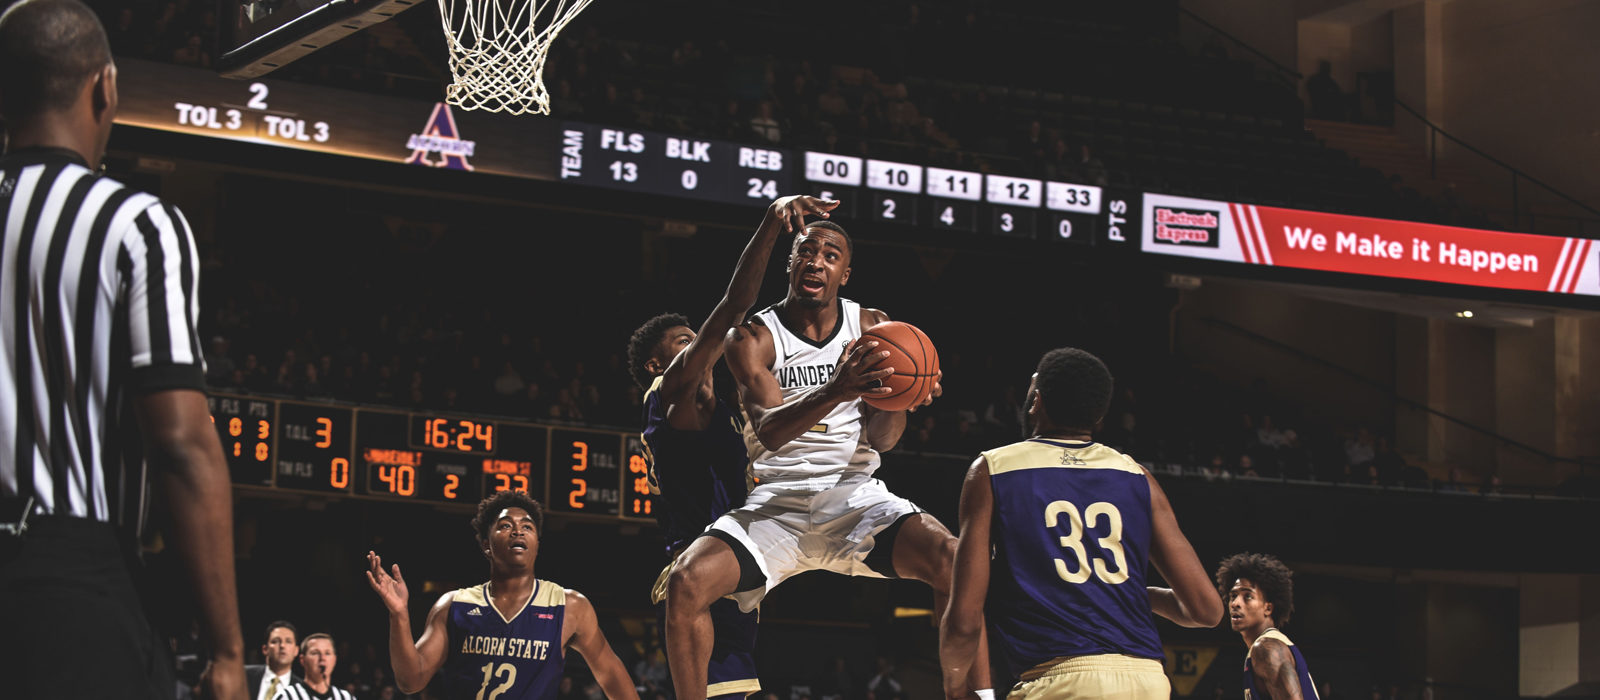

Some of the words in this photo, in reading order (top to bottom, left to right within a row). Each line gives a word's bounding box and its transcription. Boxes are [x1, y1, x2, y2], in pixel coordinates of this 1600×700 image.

[248, 83, 268, 110] 2
[175, 103, 222, 129] TOL
[227, 110, 242, 129] 3
[264, 115, 310, 140] TOL
[314, 122, 330, 142] 3
[600, 129, 645, 153] FLS
[665, 138, 711, 162] BLK
[561, 130, 583, 178] TEAM
[739, 147, 783, 171] REB
[609, 161, 638, 182] 13
[681, 170, 698, 190] 0
[823, 159, 849, 178] 00
[885, 169, 909, 186] 10
[747, 178, 778, 200] 24
[945, 176, 968, 193] 11
[1006, 182, 1030, 200] 12
[882, 199, 896, 219] 2
[1065, 188, 1091, 206] 33
[940, 206, 954, 226] 4
[1001, 213, 1014, 232] 3
[1108, 200, 1127, 242] PTS
[1156, 209, 1217, 228] Electronic
[1059, 219, 1072, 238] 0
[1156, 224, 1209, 243] Express
[1283, 226, 1327, 251] We
[1336, 231, 1403, 259] Make
[1412, 238, 1431, 262] it
[1439, 243, 1538, 273] Happen
[258, 420, 270, 440] 3
[315, 417, 332, 448] 3
[424, 419, 493, 451] 16:24
[571, 441, 588, 471] 3
[330, 457, 349, 488] 0
[379, 465, 415, 496] 40
[443, 474, 459, 499] 2
[569, 478, 587, 509] 2
[1044, 500, 1130, 585] 33
[462, 635, 507, 657] ALCORN
[508, 637, 550, 661] STATE
[476, 662, 517, 700] 12
